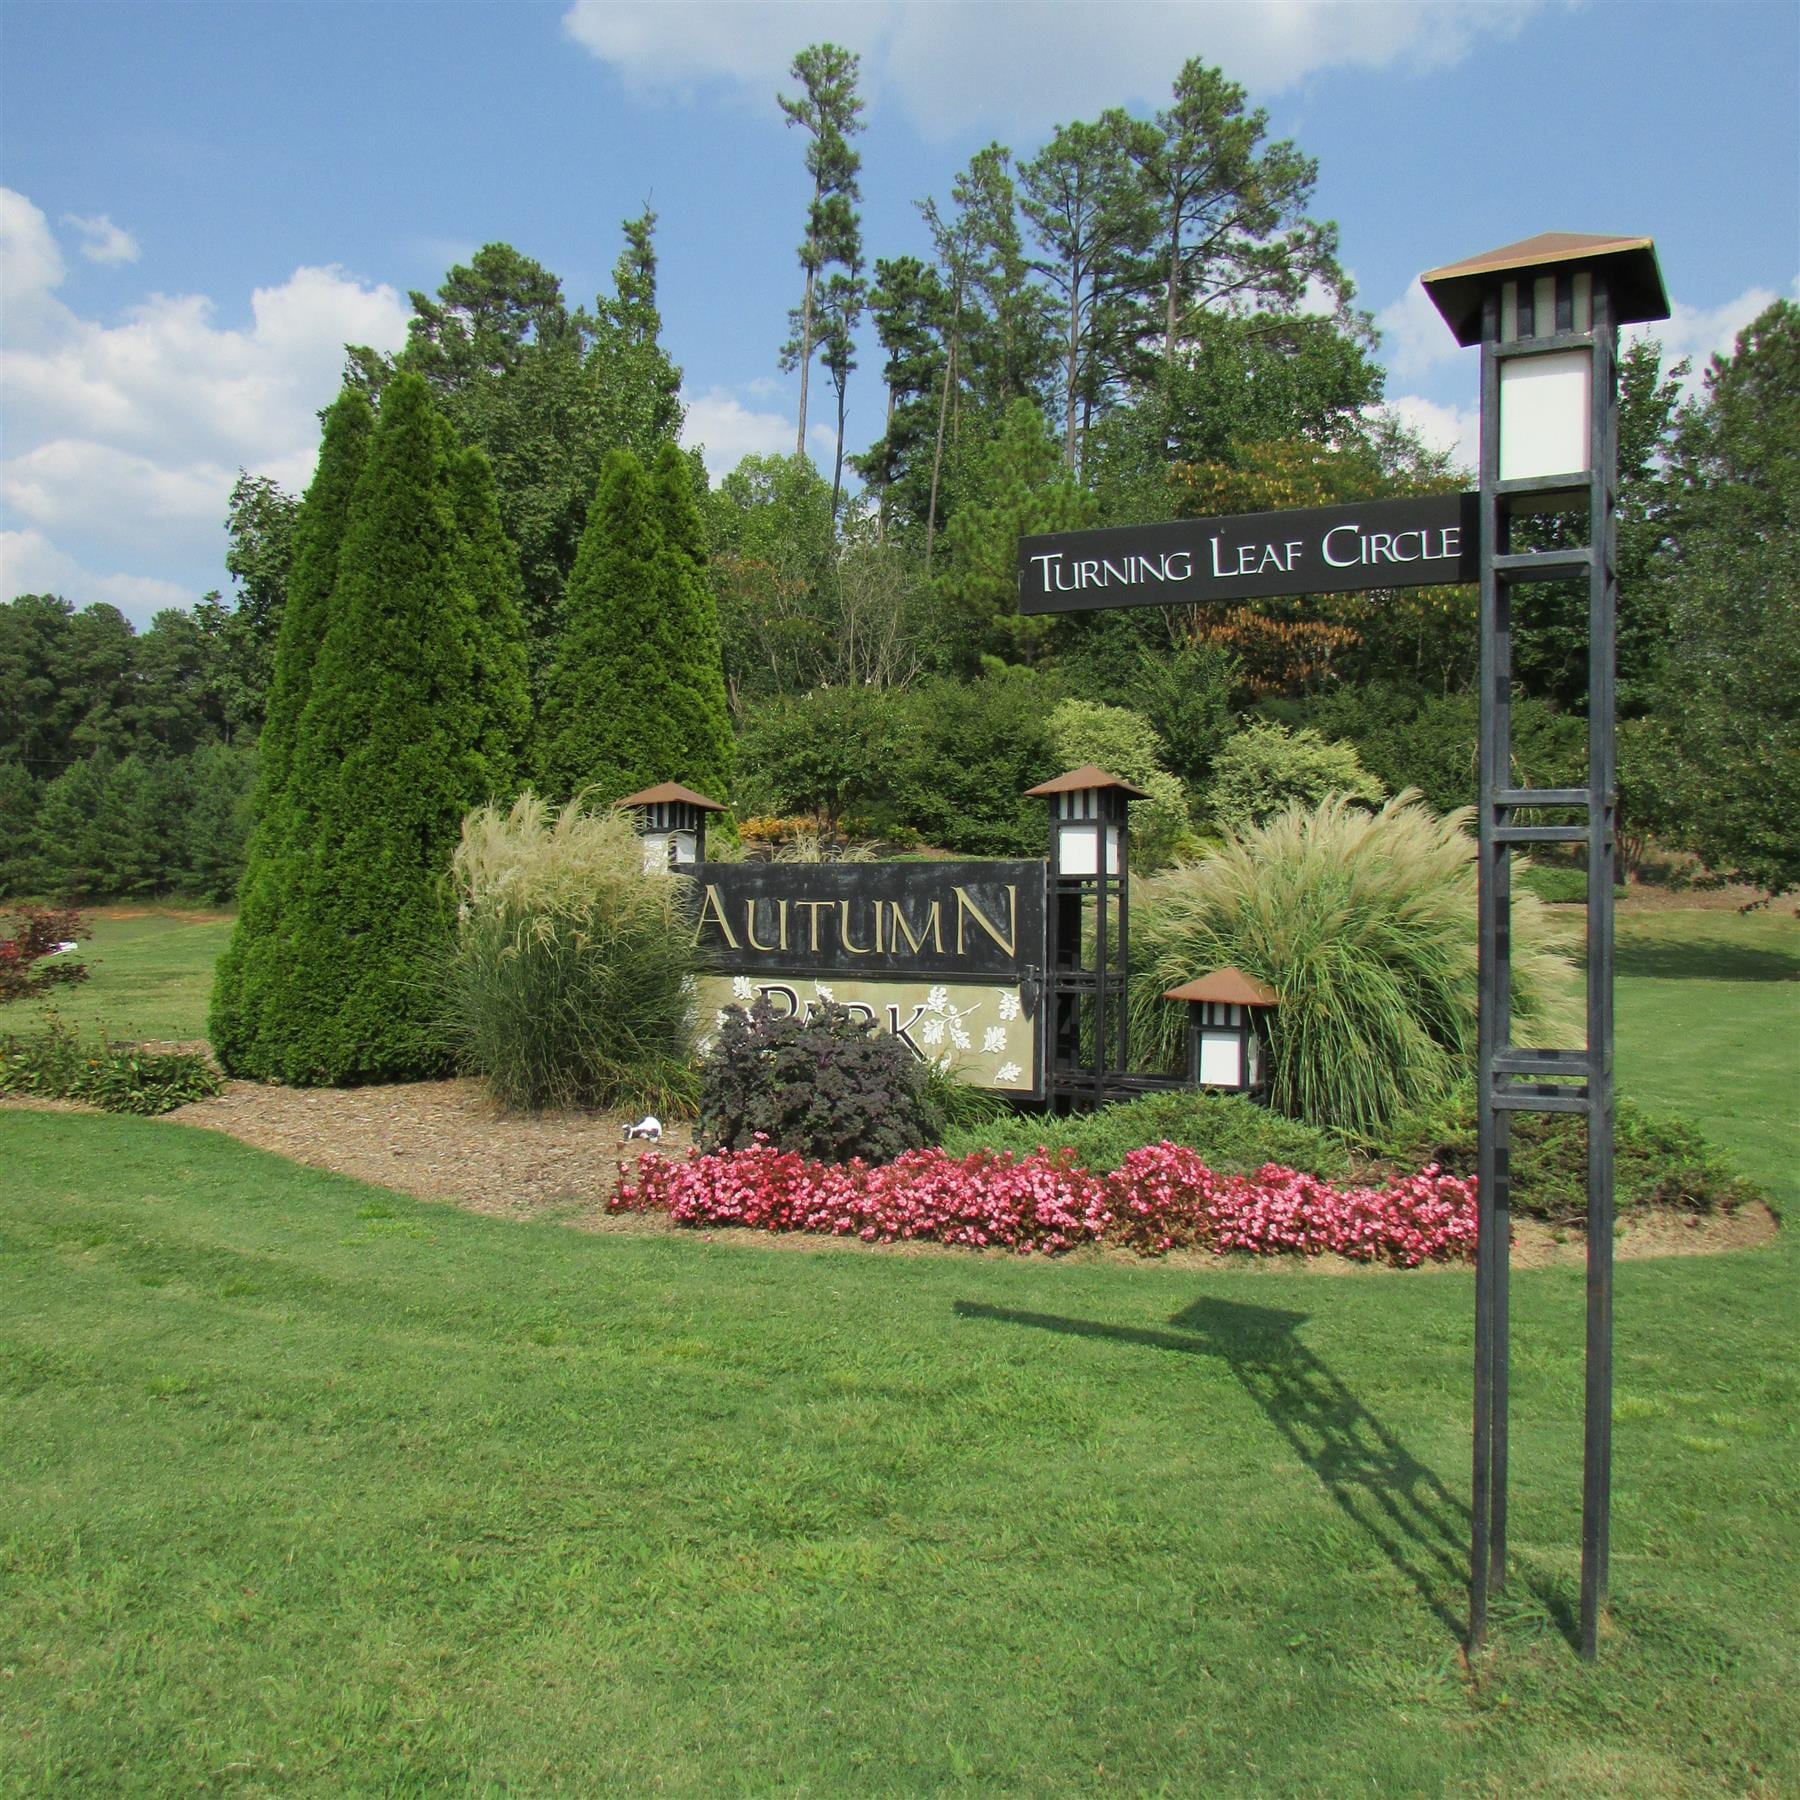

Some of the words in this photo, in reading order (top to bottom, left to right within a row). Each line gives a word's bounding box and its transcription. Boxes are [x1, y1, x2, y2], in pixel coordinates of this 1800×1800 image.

[1030, 552, 1192, 592] TURNING
[1208, 536, 1303, 578] LEAF
[1321, 525, 1463, 569] CIRCLE
[690, 884, 1017, 958] AUTUMN
